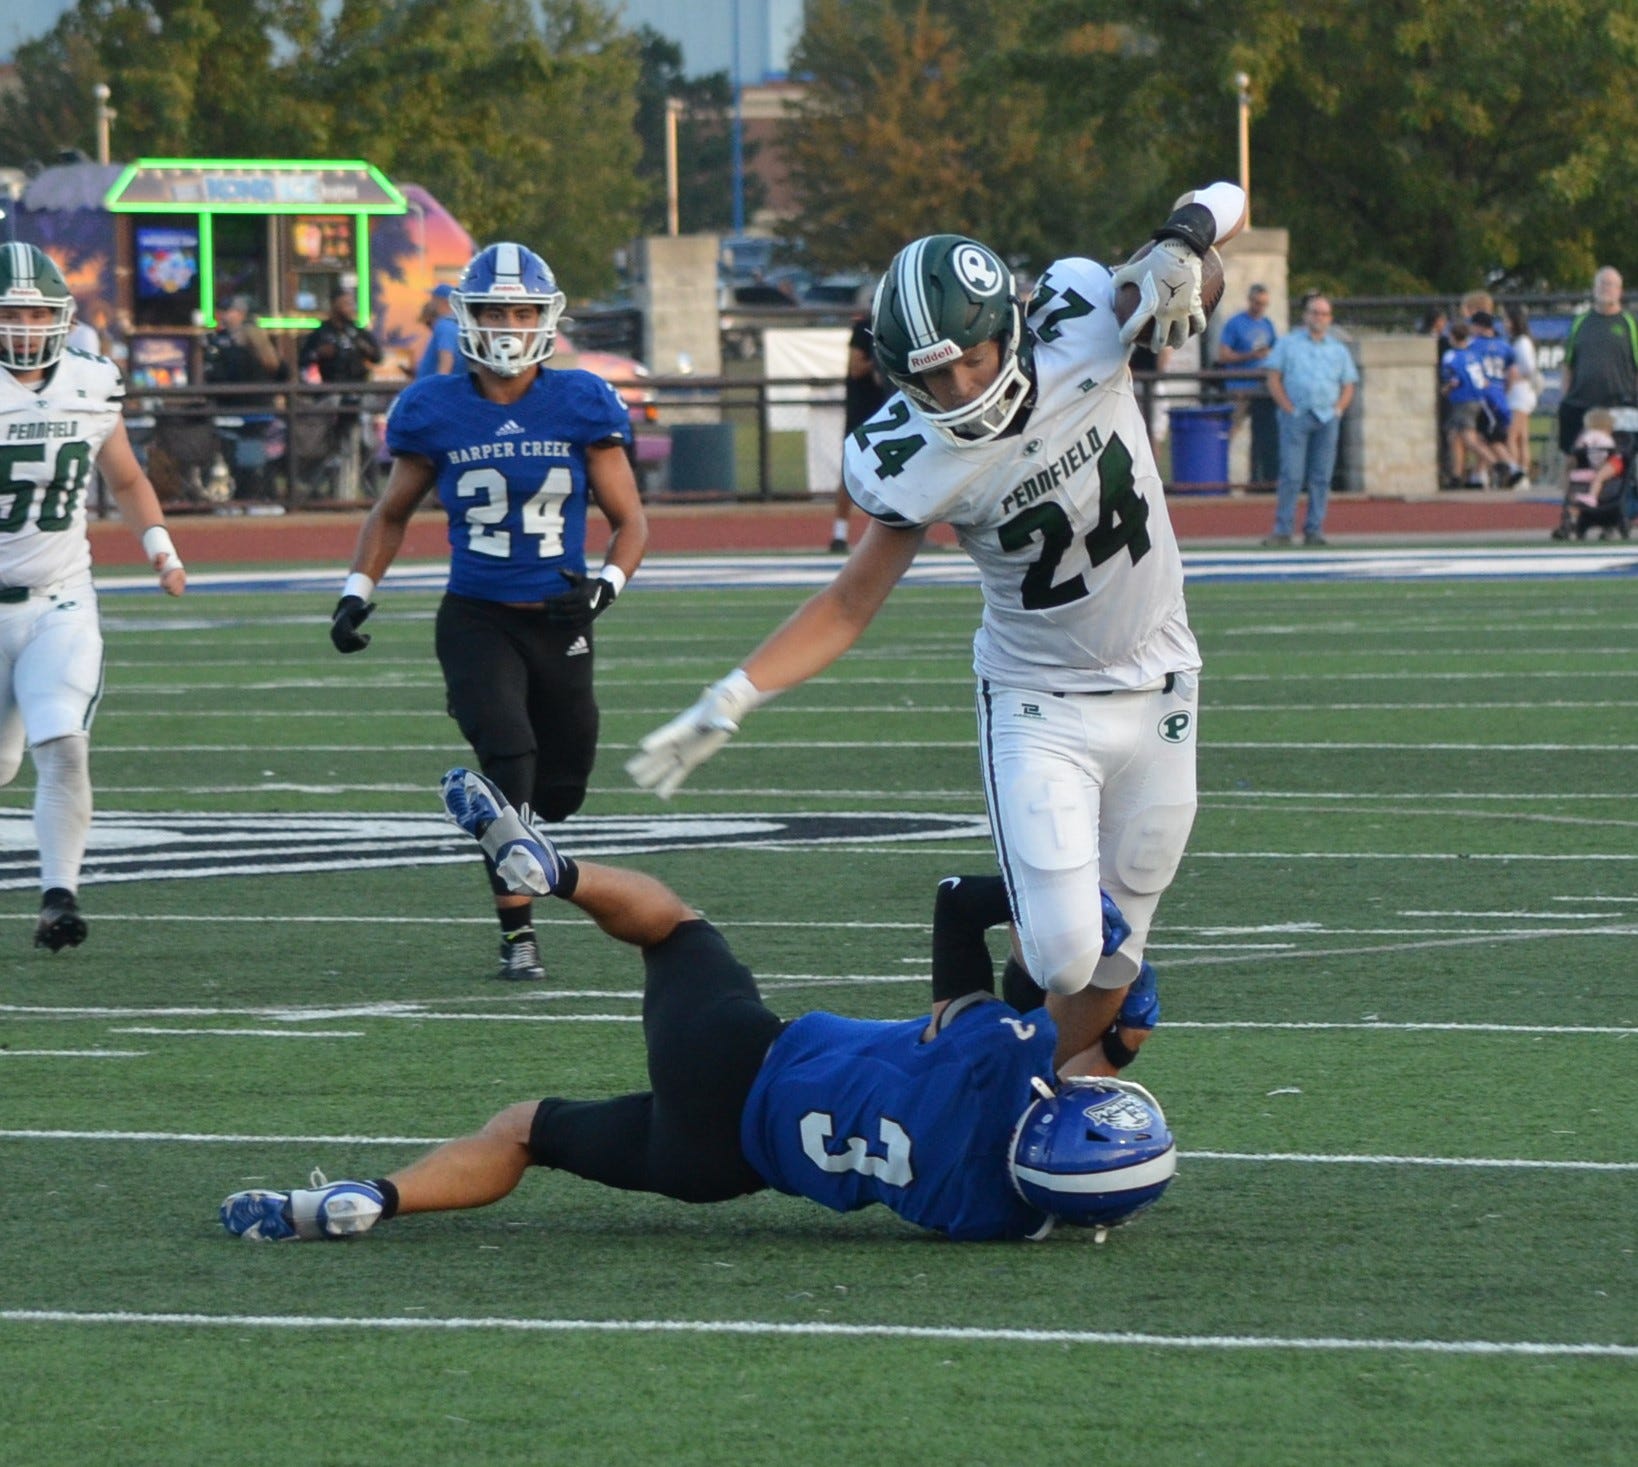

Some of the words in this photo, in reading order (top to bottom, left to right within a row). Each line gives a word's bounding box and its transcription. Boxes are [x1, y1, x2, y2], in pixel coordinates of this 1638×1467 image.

[911, 346, 953, 367] Riddell
[6, 421, 78, 440] PENNFIELD
[447, 442, 516, 464] HARPER
[520, 441, 572, 457] CREEK
[853, 400, 927, 481] 24
[0, 440, 91, 533] 50
[1001, 426, 1104, 515] PENNFIELD
[457, 467, 573, 558] 24
[998, 430, 1152, 611] 24
[1162, 713, 1189, 739] P
[799, 1110, 915, 1188] 3
